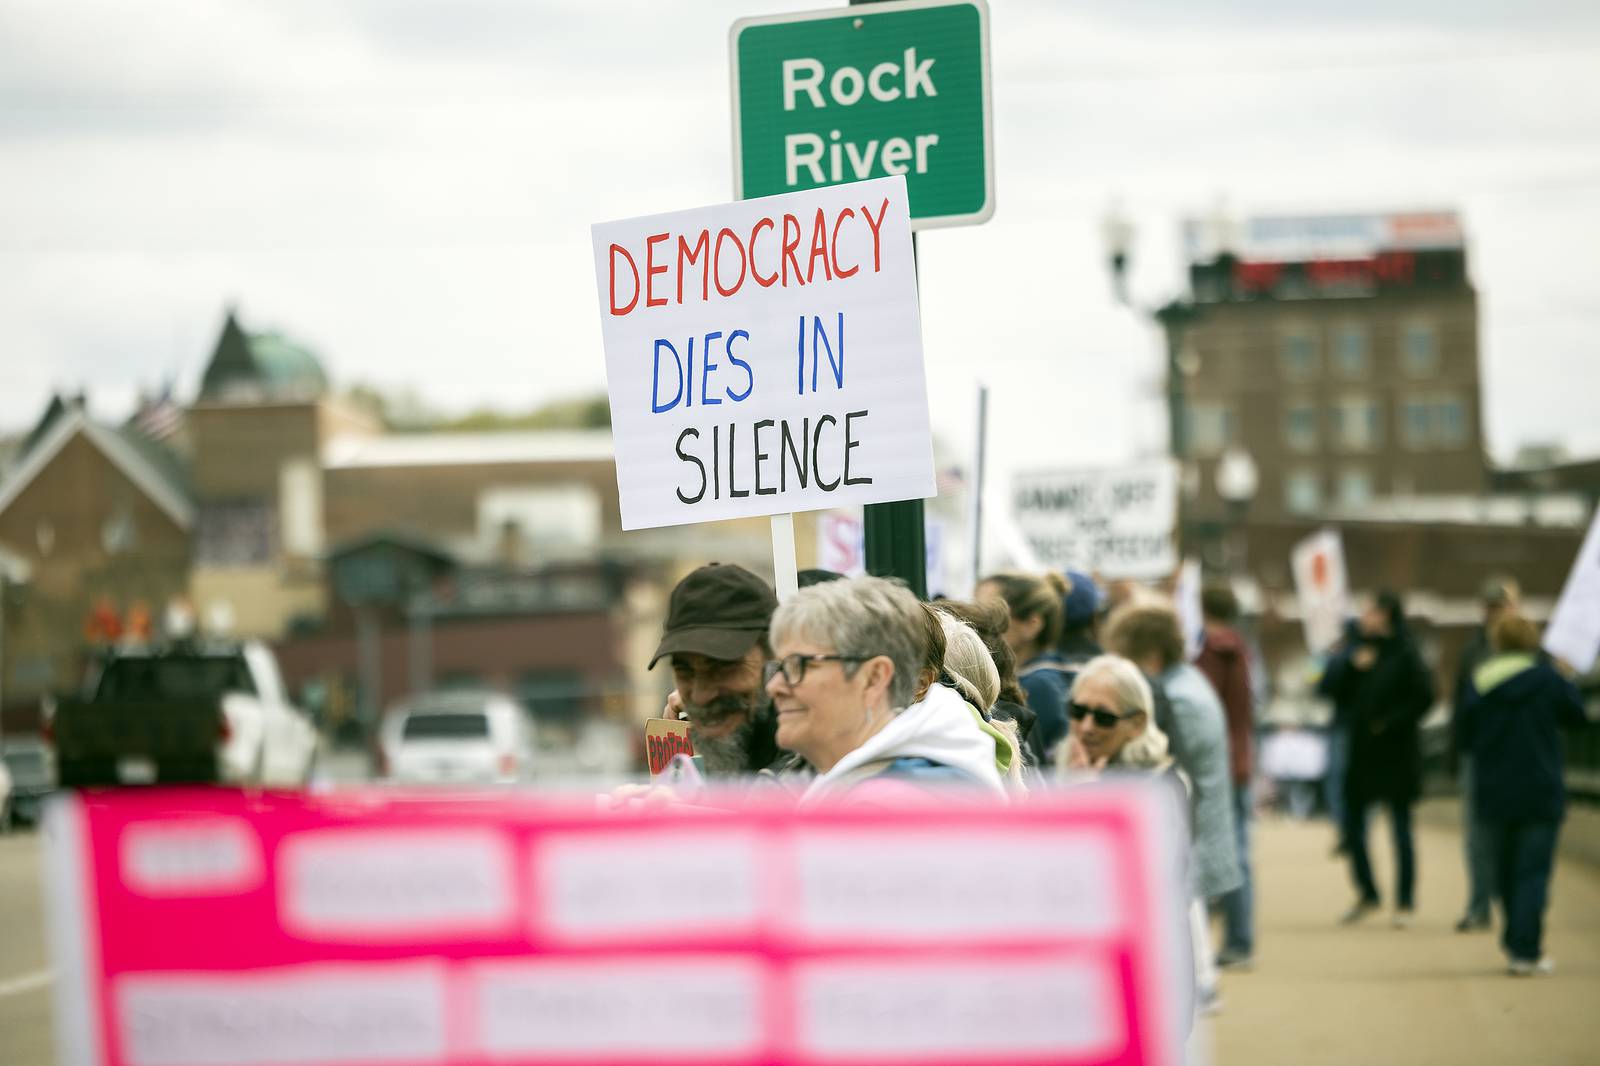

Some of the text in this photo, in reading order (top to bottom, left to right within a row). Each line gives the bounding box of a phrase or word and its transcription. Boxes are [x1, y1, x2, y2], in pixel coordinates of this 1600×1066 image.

[783, 47, 938, 111] Rock
[785, 129, 939, 186] River
[609, 198, 889, 316] DEMOCRACY
[652, 312, 844, 414] DIES IN
[675, 410, 873, 504] SILENCE
